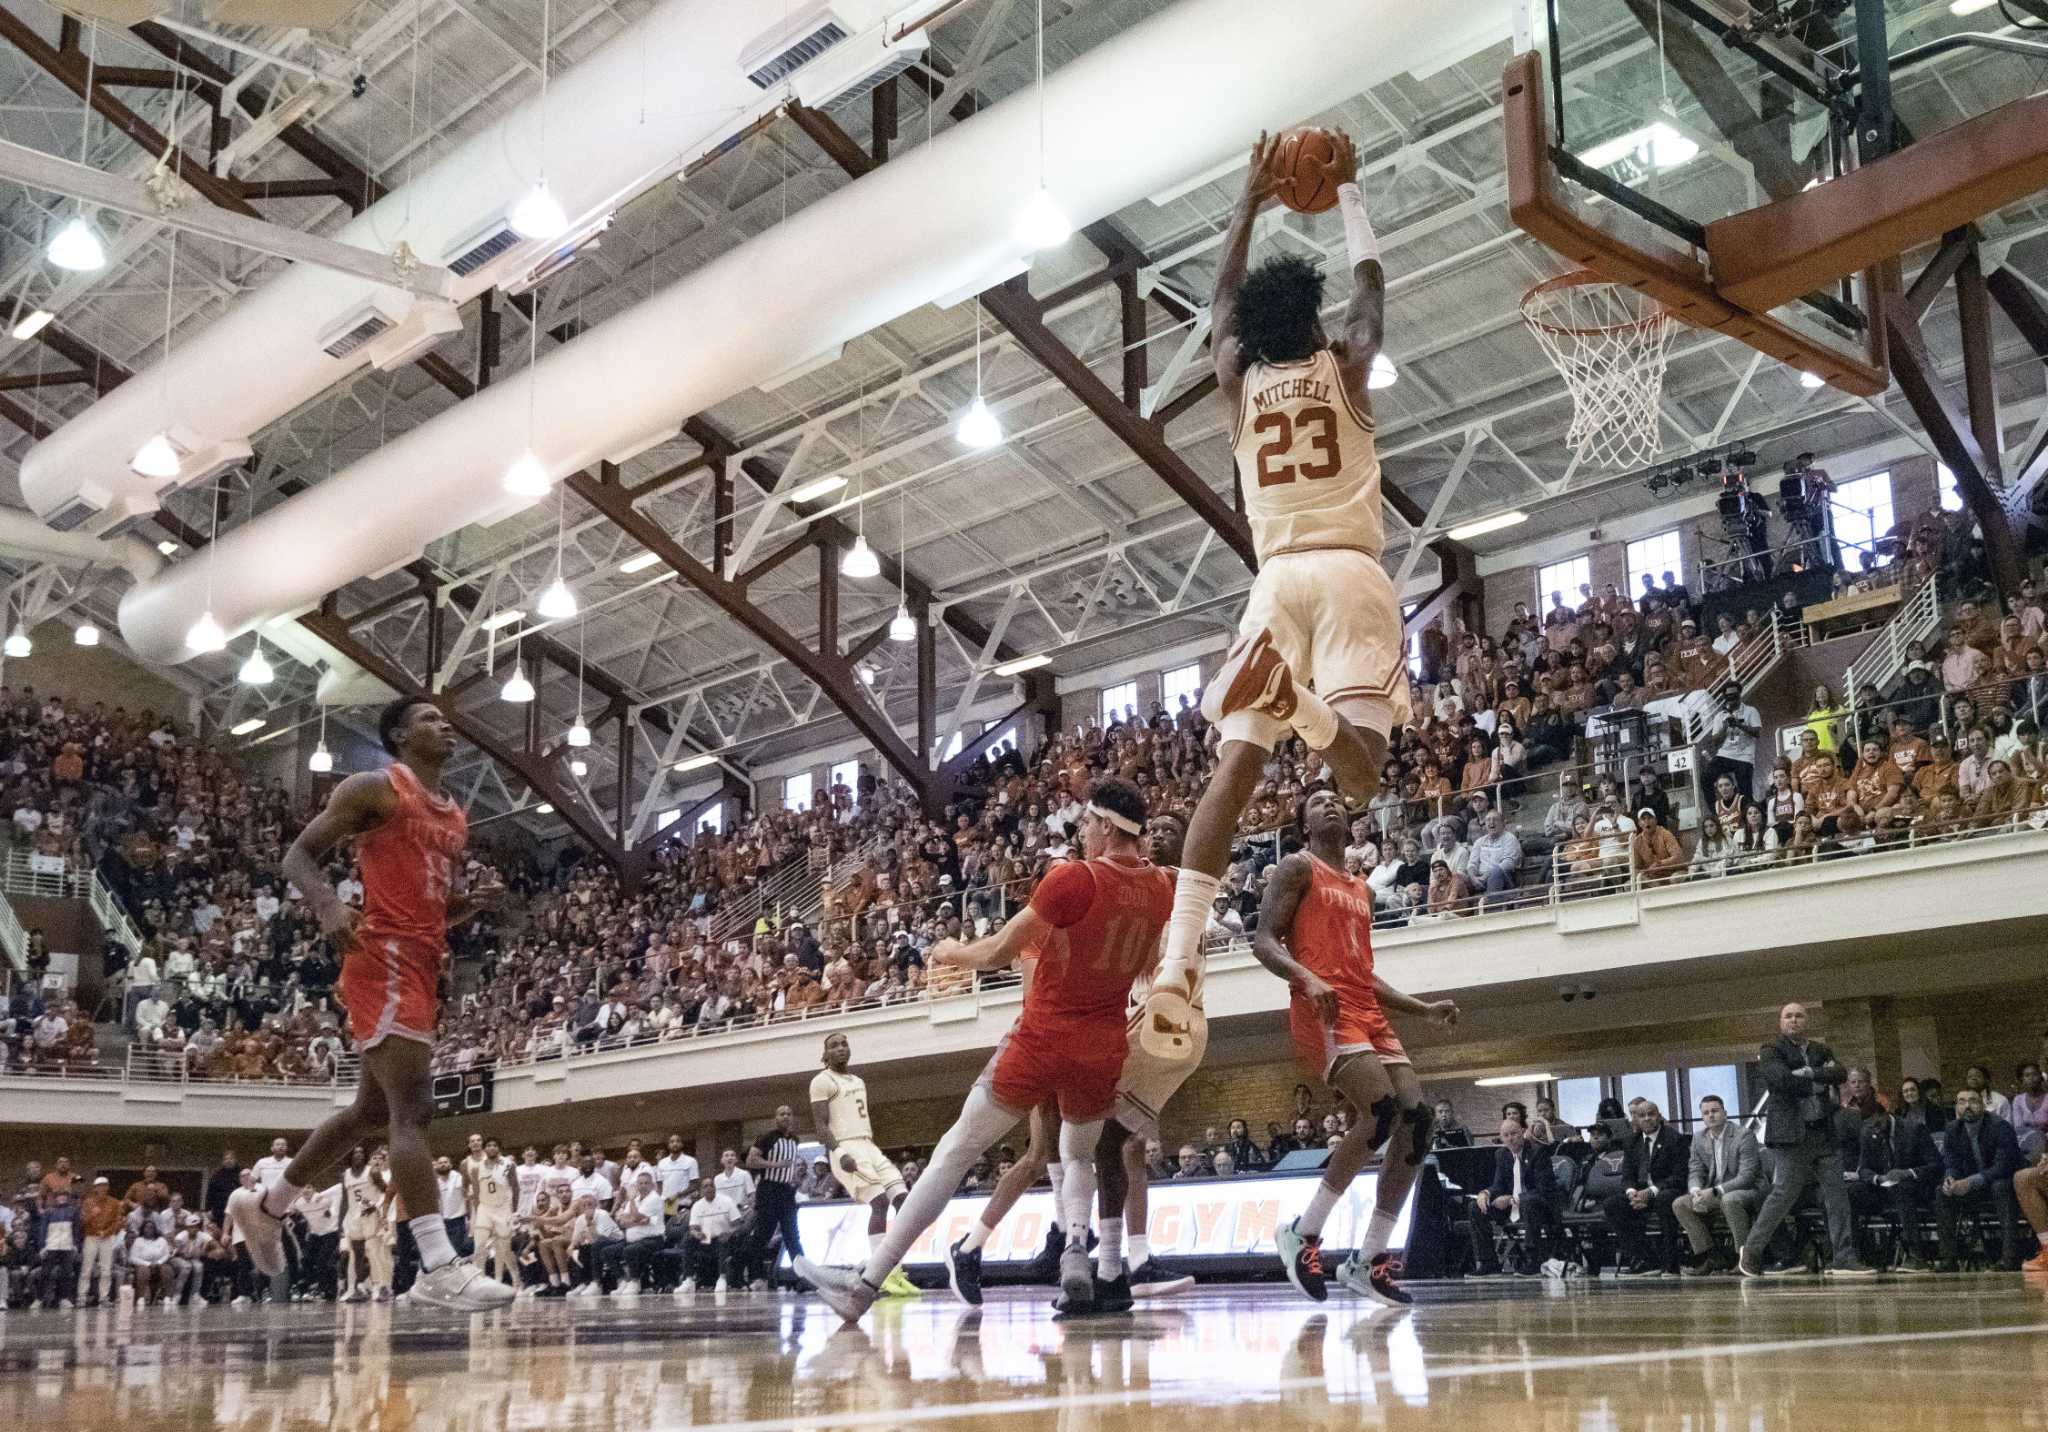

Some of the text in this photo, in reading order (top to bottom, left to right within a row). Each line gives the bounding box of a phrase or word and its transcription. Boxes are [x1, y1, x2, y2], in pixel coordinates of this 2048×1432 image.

[1253, 379, 1331, 412] MITCHELL
[1254, 406, 1342, 488] 23
[1674, 756, 1687, 769] 42
[1091, 915, 1150, 974] 10
[856, 1098, 867, 1119] 2
[353, 1188, 362, 1203] 5
[488, 1181, 496, 1194] 0
[1150, 1199, 1281, 1246] GYM
